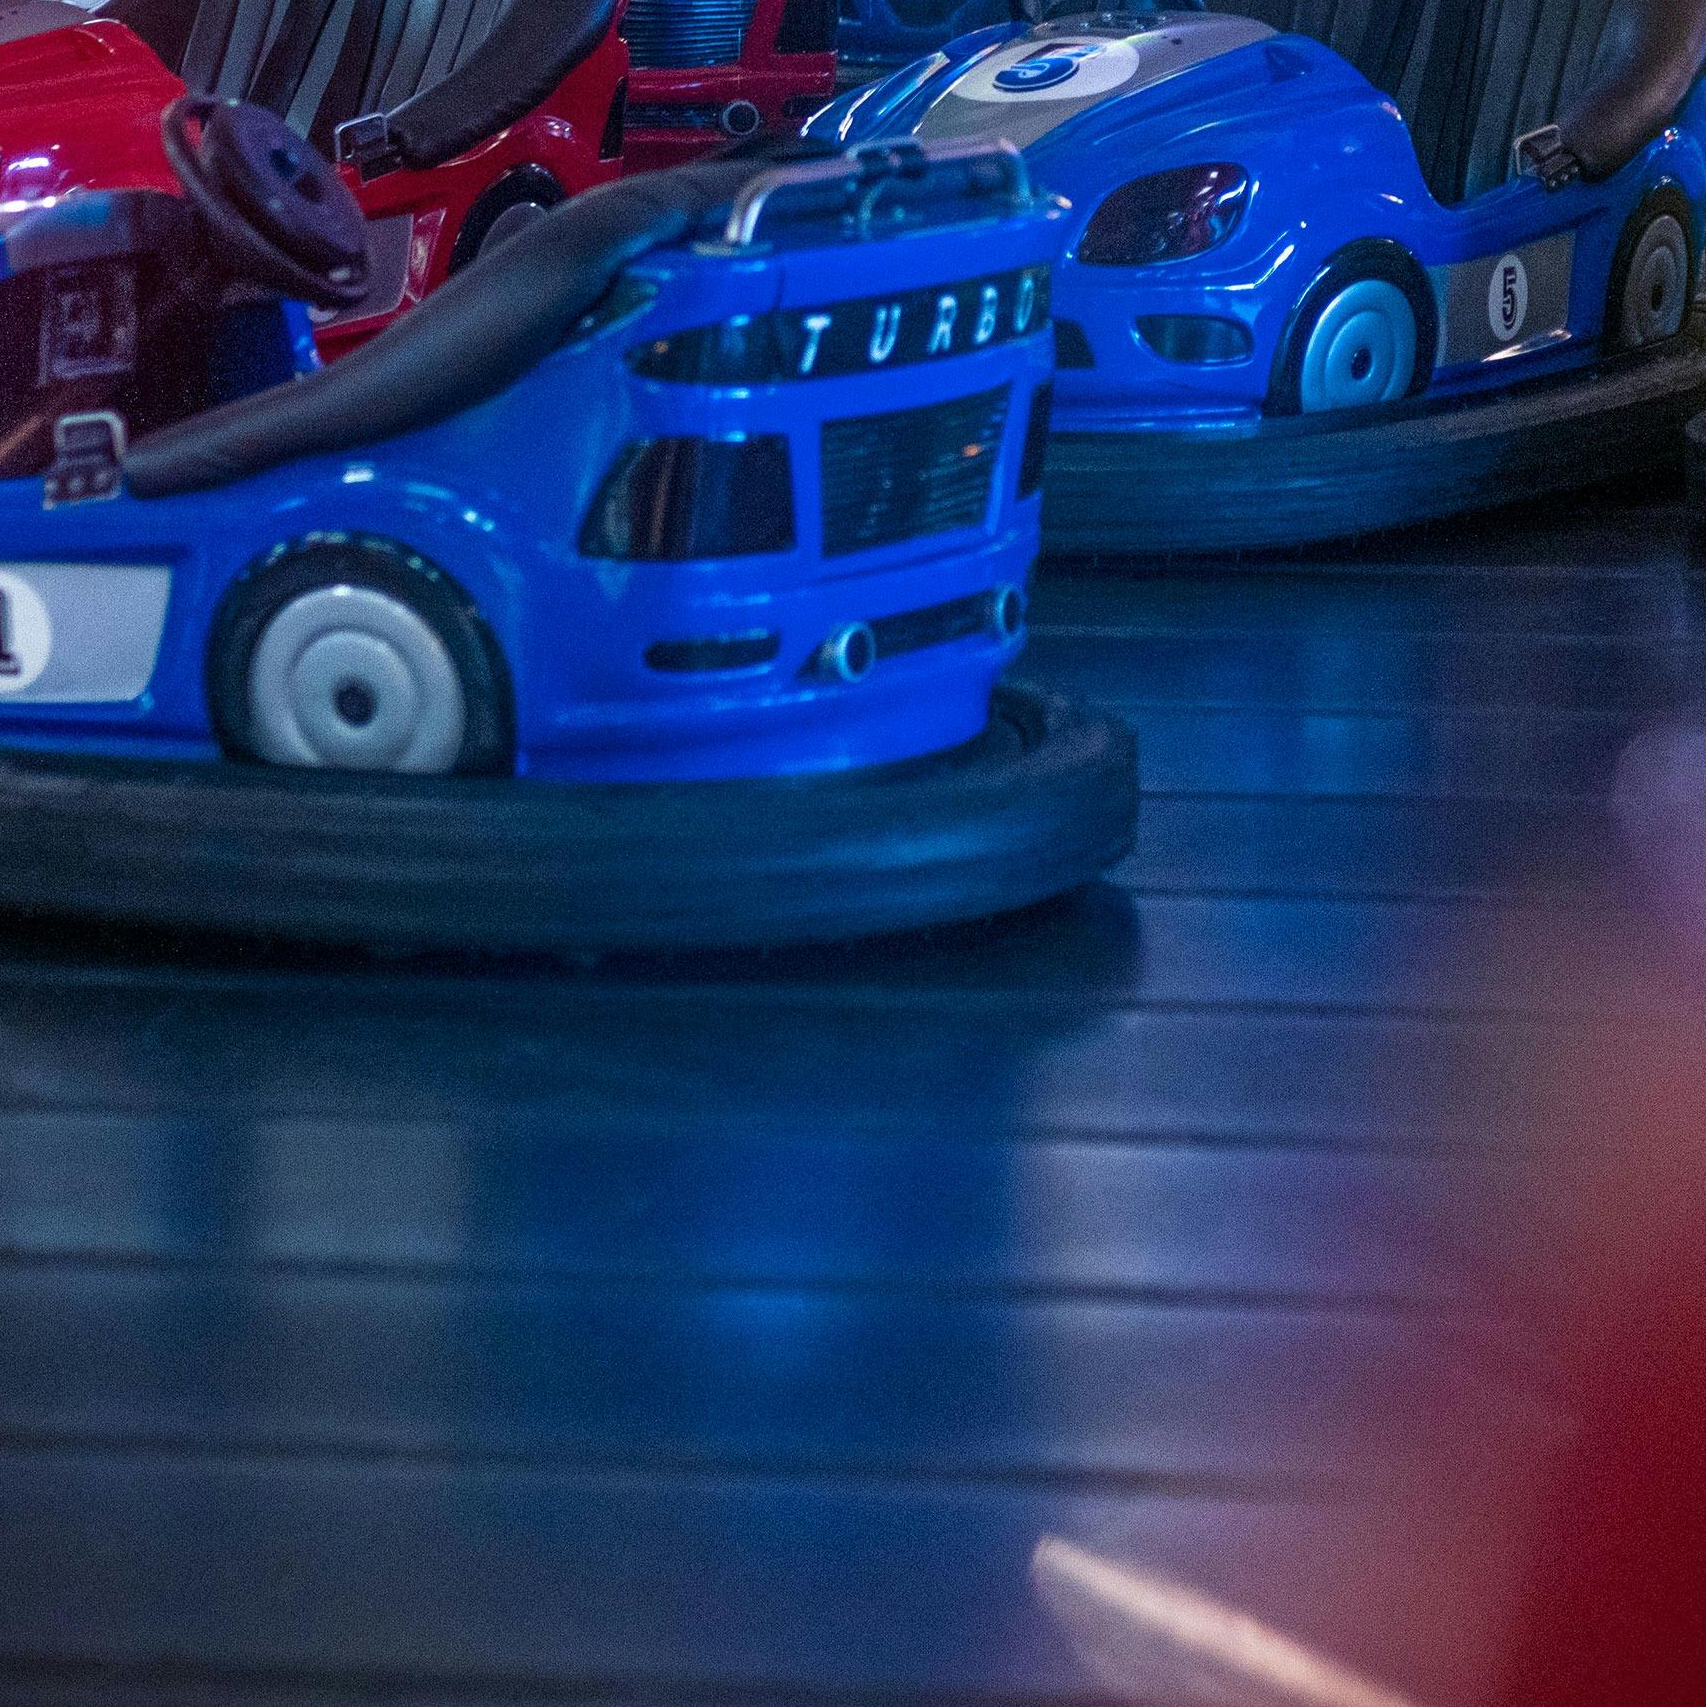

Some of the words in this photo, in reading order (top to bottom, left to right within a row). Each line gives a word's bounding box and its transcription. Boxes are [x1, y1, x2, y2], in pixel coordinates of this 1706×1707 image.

[992, 42, 1106, 94] 5
[800, 271, 1036, 374] TURBO
[1501, 265, 1517, 331] 5
